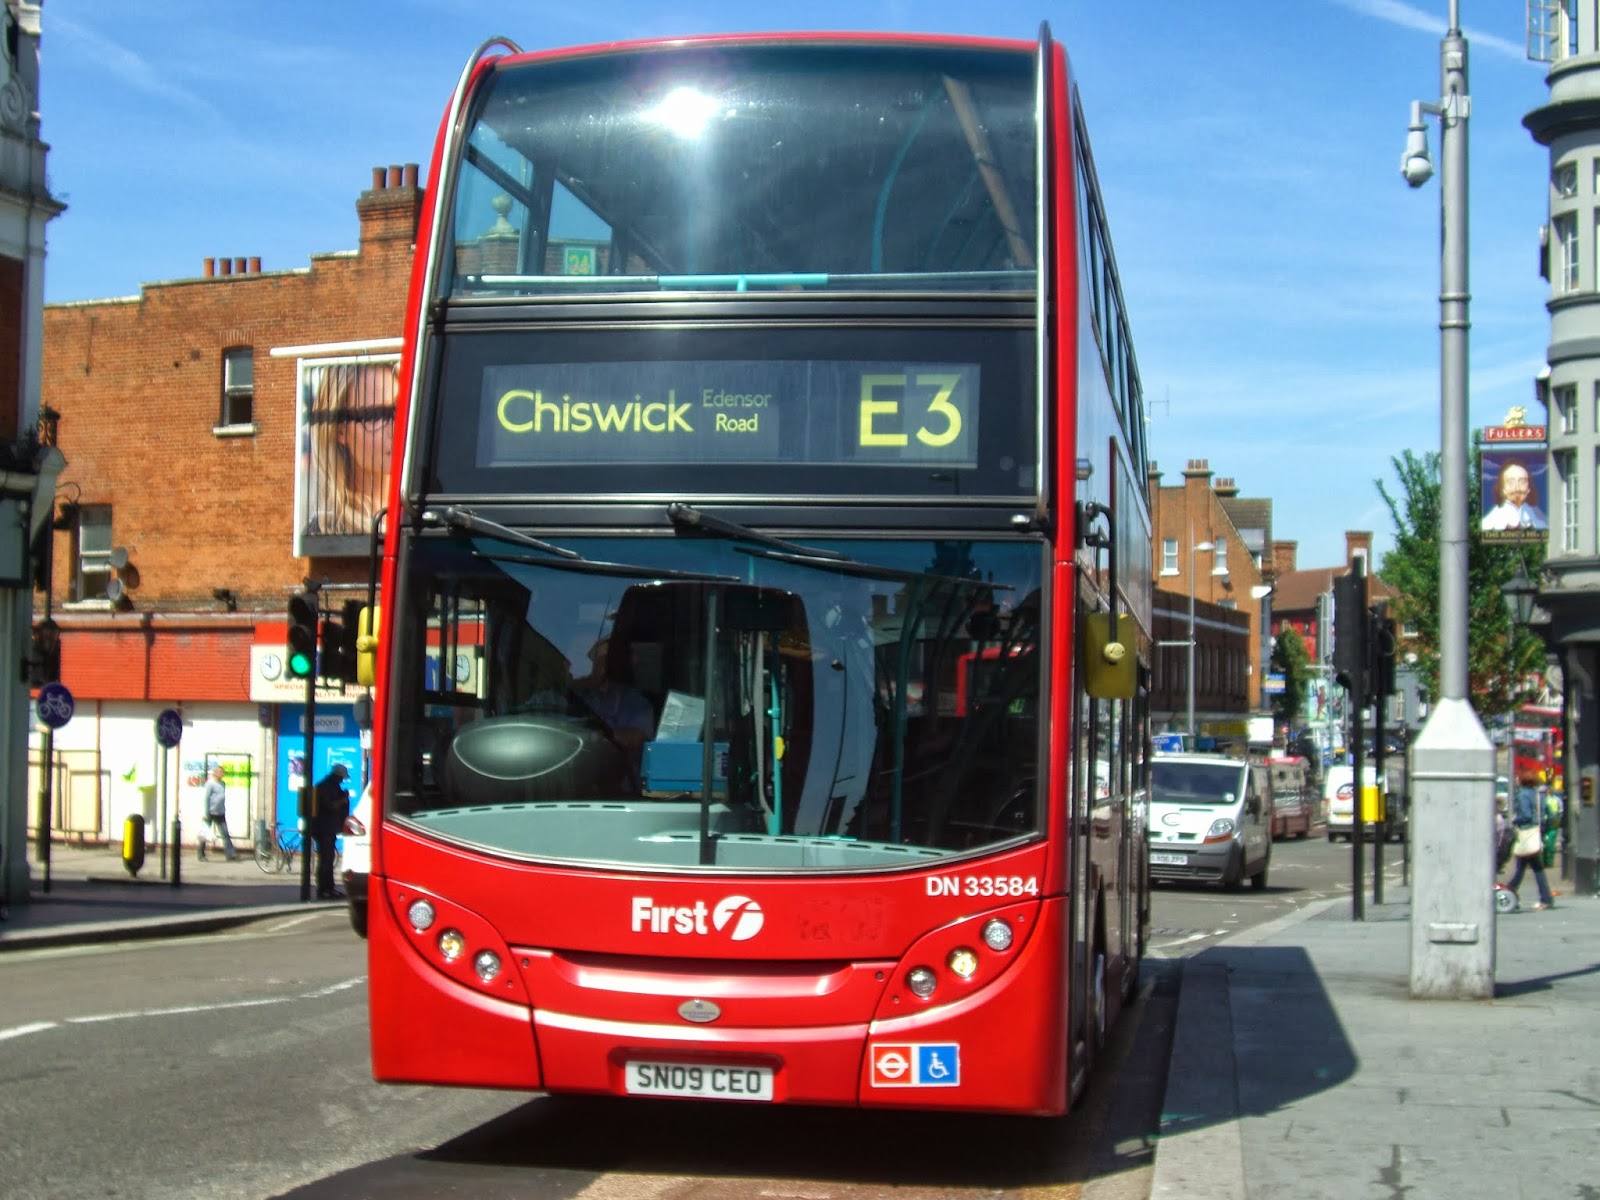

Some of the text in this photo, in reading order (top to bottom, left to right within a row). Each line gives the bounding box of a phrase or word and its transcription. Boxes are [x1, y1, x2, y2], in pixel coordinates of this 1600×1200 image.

[497, 389, 694, 432] Chiswick
[702, 389, 772, 407] Edensor
[860, 373, 962, 447] E3
[715, 413, 759, 432] Road
[926, 876, 1038, 897] DN 33584
[631, 896, 707, 934] First
[637, 1064, 761, 1094] SN09 CEO
